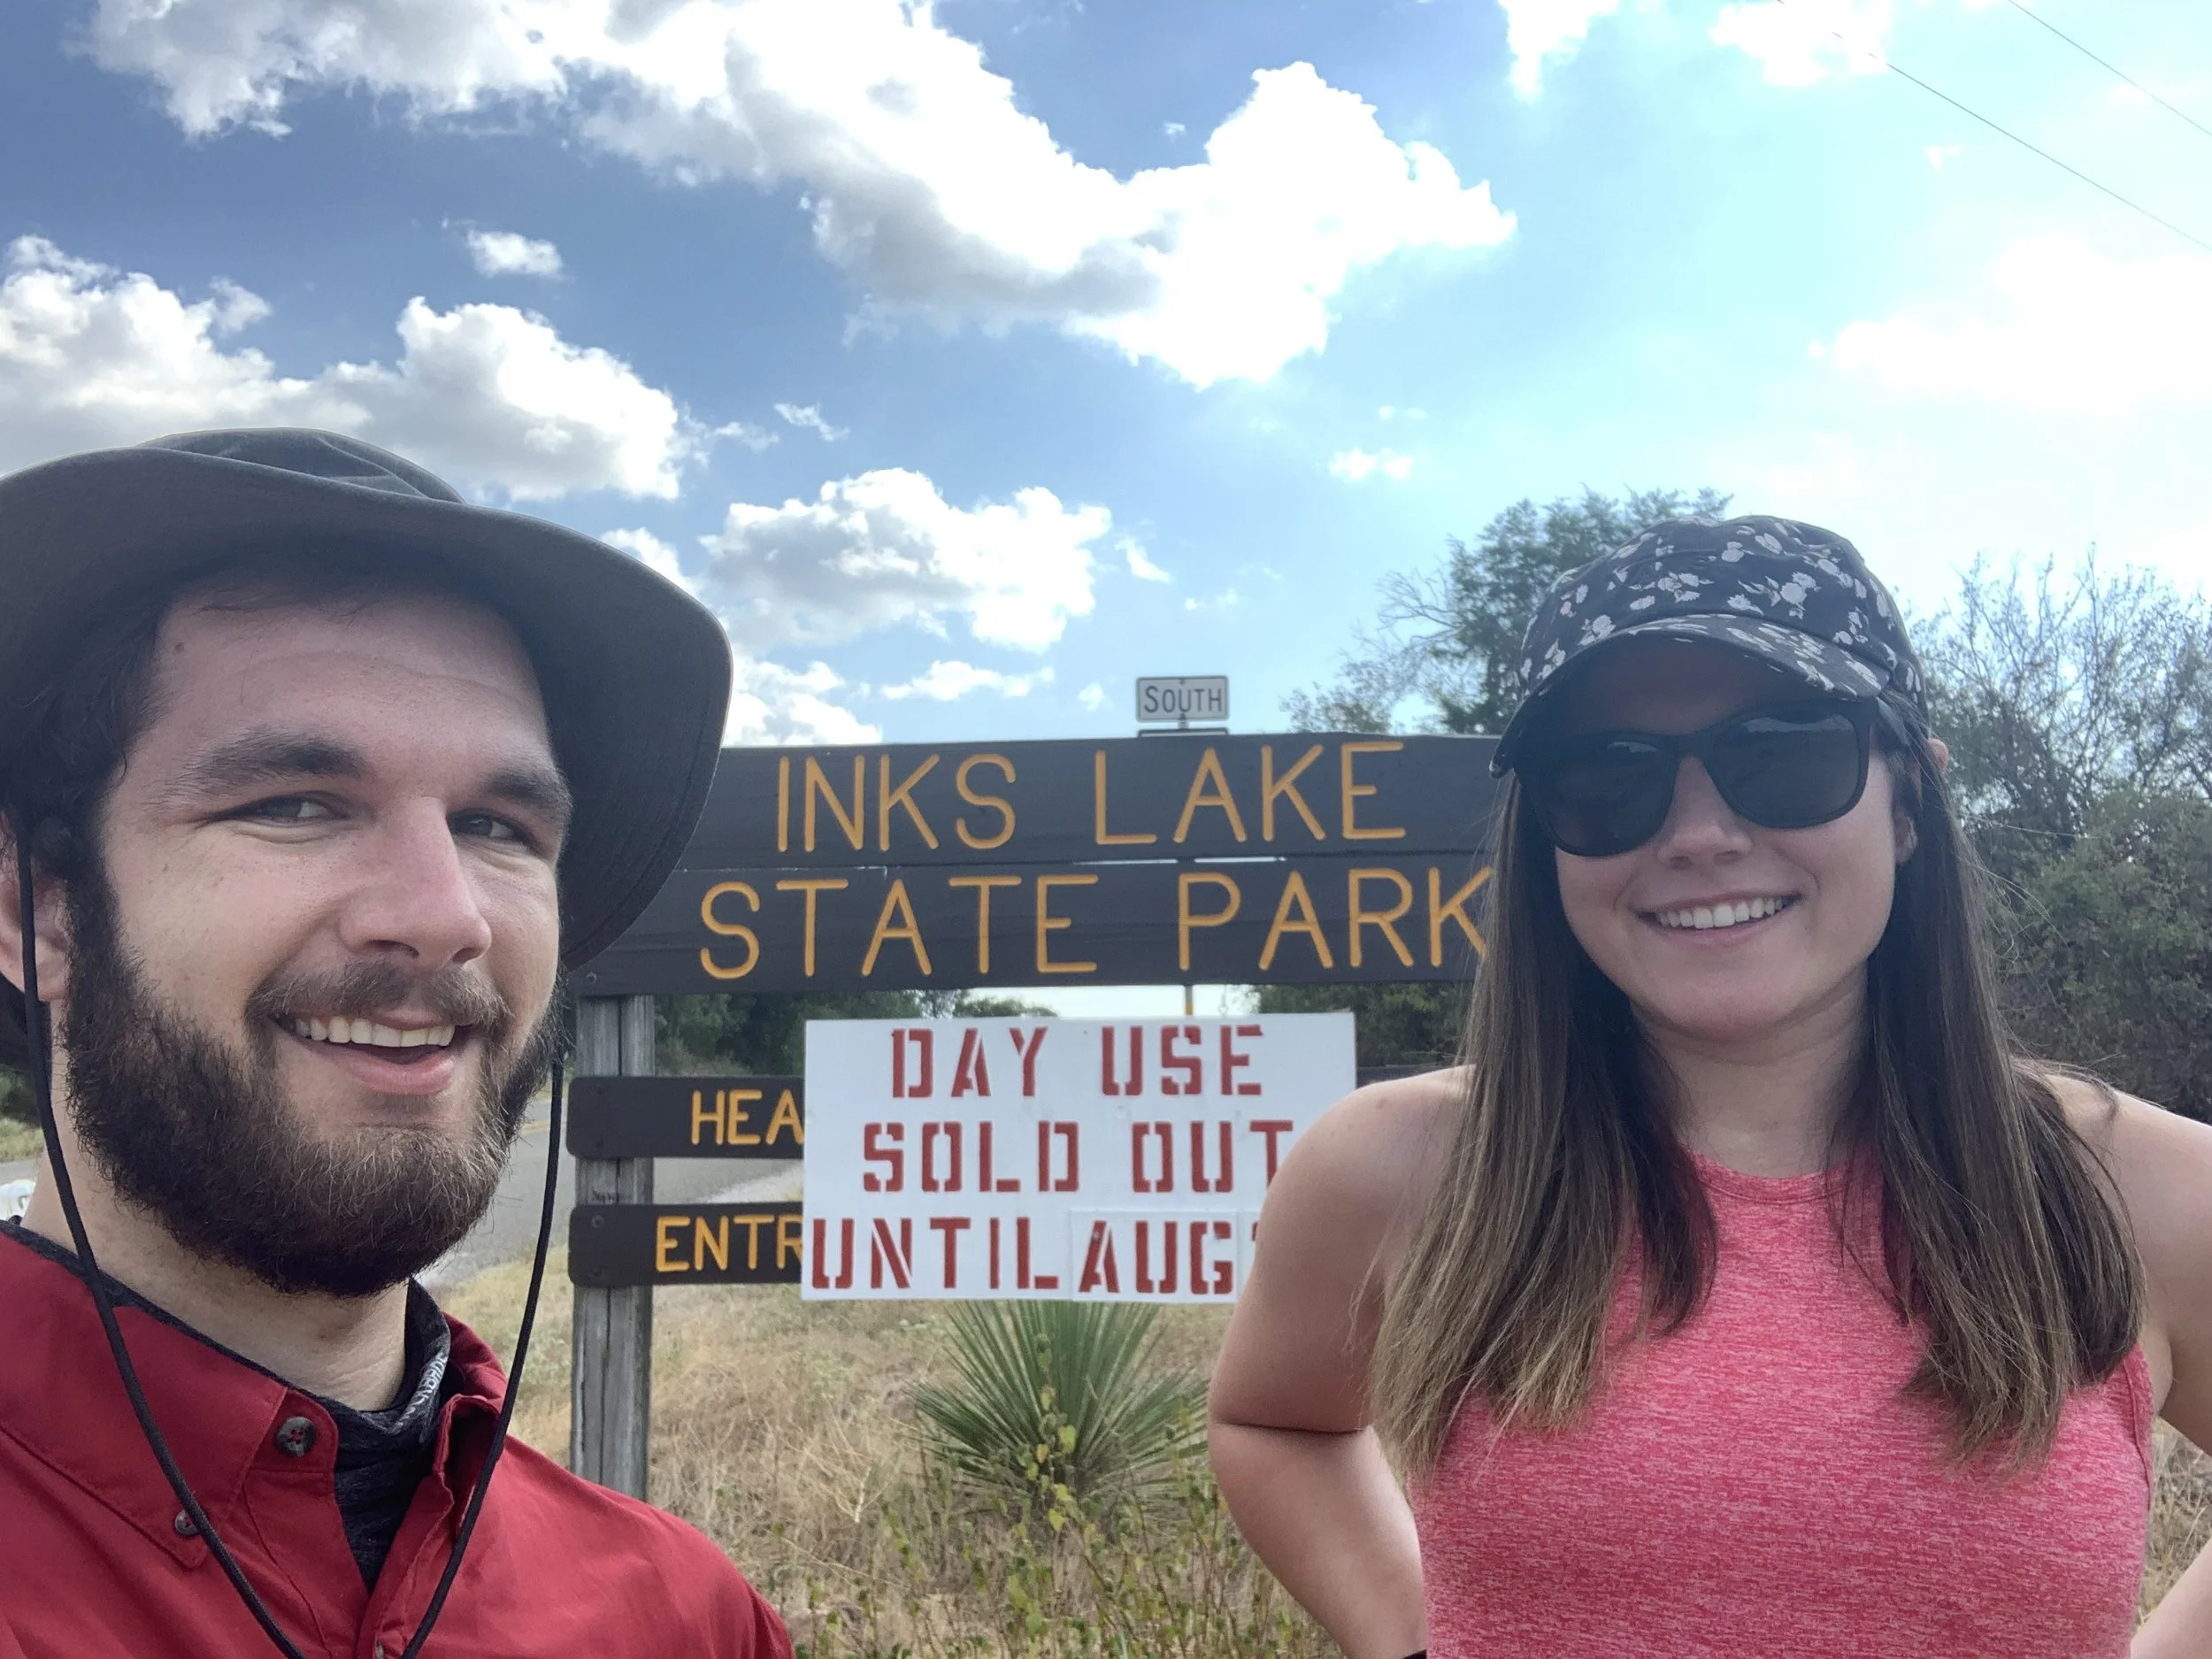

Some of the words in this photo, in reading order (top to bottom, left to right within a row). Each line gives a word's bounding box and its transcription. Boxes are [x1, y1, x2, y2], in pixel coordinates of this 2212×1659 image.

[1143, 685, 1222, 714] SOUTH
[777, 753, 1017, 853] INKS
[1094, 741, 1407, 845] LAKE
[700, 873, 1099, 979] STATE
[1178, 866, 1494, 972] PARK
[891, 1025, 1049, 1098] DAY
[1101, 1024, 1263, 1096] USE
[863, 1120, 1079, 1193] SOLD
[1131, 1119, 1294, 1194] OUT
[811, 1217, 1059, 1290] UNTIL
[1078, 1219, 1233, 1295] AUG
